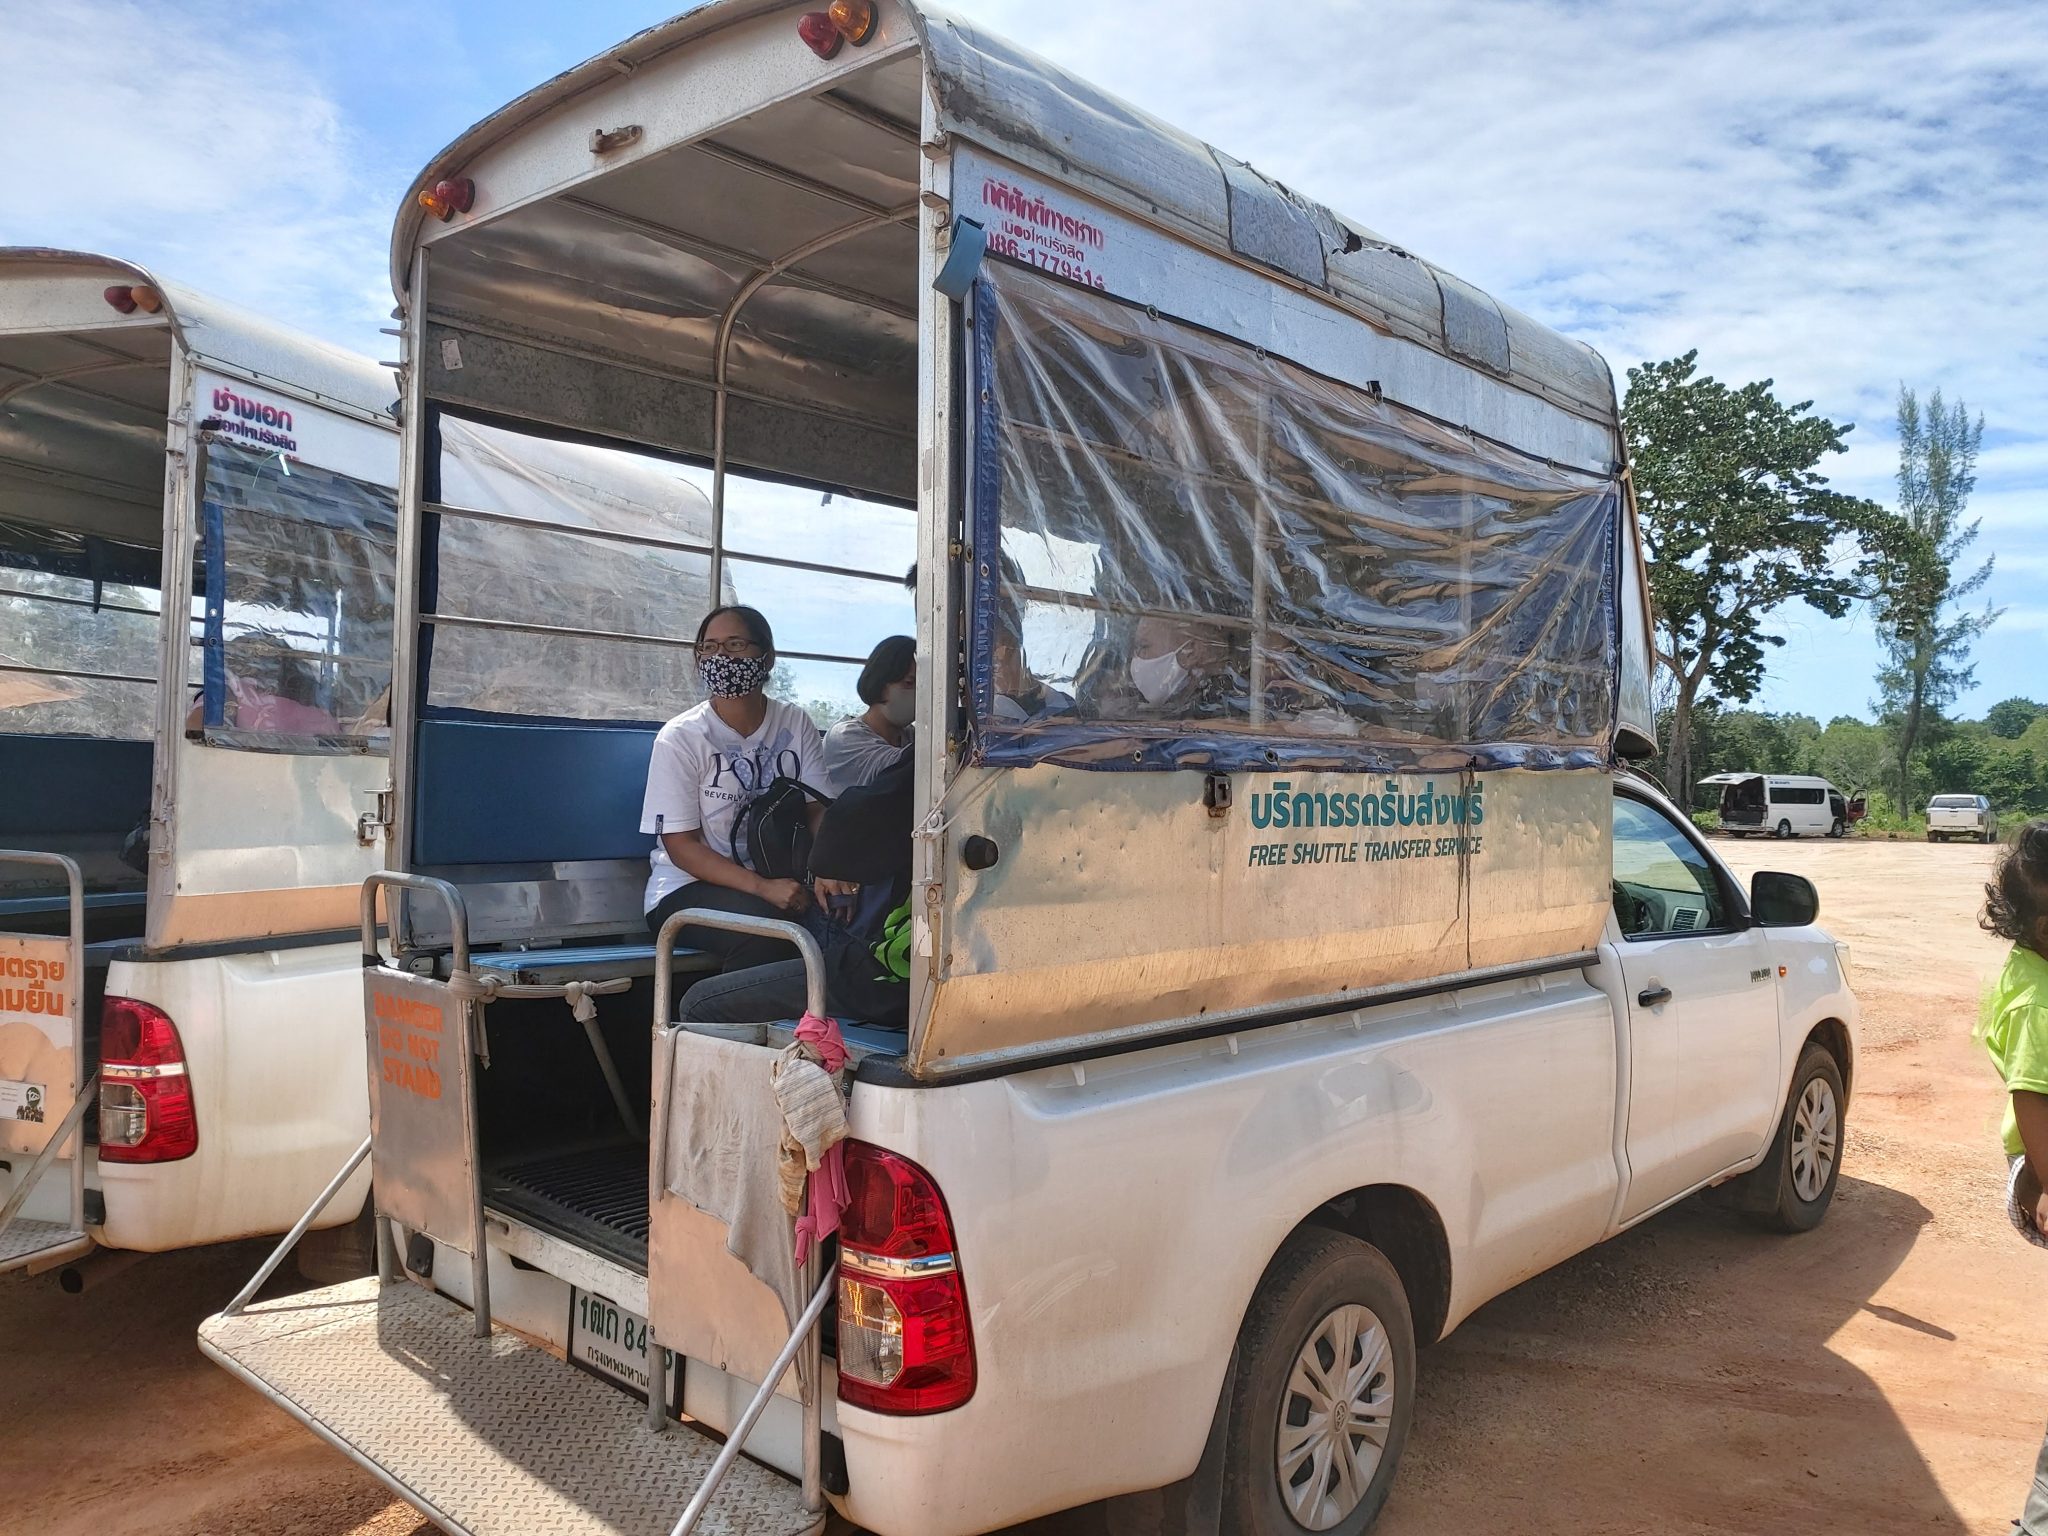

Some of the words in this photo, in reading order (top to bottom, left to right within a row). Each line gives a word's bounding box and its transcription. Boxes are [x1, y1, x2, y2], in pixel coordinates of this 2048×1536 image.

[213, 387, 292, 432] ช่างเอก
[704, 789, 744, 802] BEVERLY
[1248, 843, 1289, 867] FREE
[1291, 842, 1358, 865] SHUTTLE
[1364, 838, 1432, 862] TRANSFER
[408, 1033, 440, 1064] NOT
[383, 1056, 442, 1101] STAND
